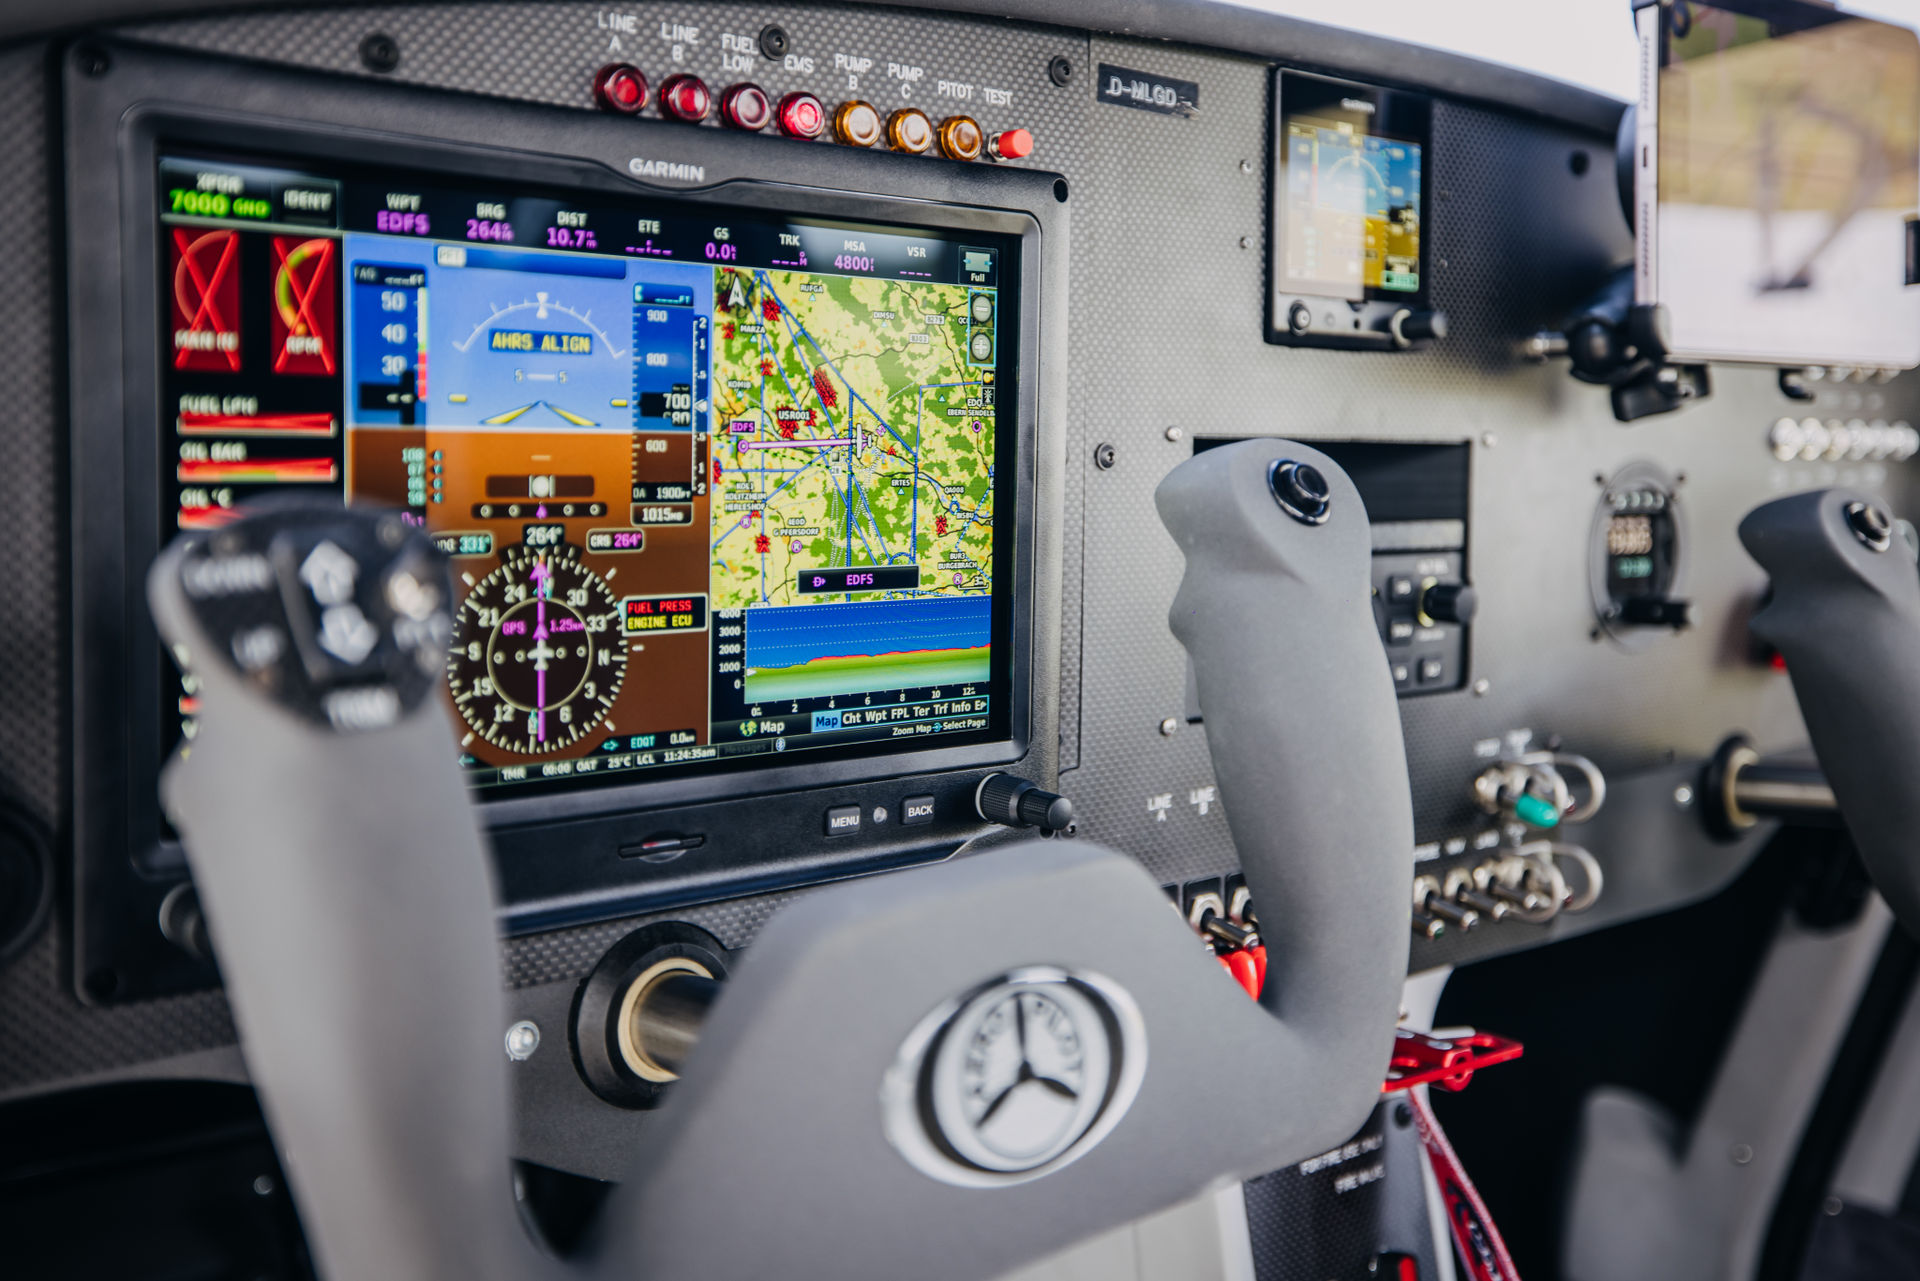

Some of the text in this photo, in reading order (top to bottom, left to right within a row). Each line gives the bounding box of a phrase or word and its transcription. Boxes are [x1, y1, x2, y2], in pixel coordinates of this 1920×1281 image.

[598, 10, 637, 34] LINE
[661, 22, 700, 45] LINE
[609, 35, 621, 50] A
[721, 33, 759, 55] FUEL
[672, 45, 683, 62] B
[723, 53, 755, 74] LOW
[784, 53, 814, 74] EMS
[834, 53, 872, 74] PUMP
[887, 62, 923, 82] PUMP
[848, 75, 858, 91] B
[901, 83, 911, 99] C
[937, 80, 974, 100] PITOT
[983, 87, 1013, 107] TEST
[629, 158, 705, 182] GARMIN
[169, 188, 271, 218] 7000 GND
[284, 189, 332, 211] IDENT
[386, 193, 421, 211] WPT
[476, 202, 506, 220] BRG
[557, 211, 587, 227] DIST
[377, 210, 430, 235] EDFS
[638, 219, 660, 234] ETE
[713, 227, 730, 241] GS
[779, 233, 800, 247] TRK
[843, 240, 866, 253] MSA
[907, 246, 927, 258] VSR
[970, 273, 985, 283] Full
[381, 290, 406, 312] 50
[647, 310, 668, 322] 900
[699, 318, 707, 329] 2
[381, 323, 406, 345] 40
[492, 333, 591, 353] AHRS ALIGN
[700, 339, 705, 350] 1
[381, 355, 406, 377] 30
[646, 353, 668, 367] 800
[514, 370, 523, 382] 5
[559, 371, 568, 383] 5
[663, 393, 690, 410] 700
[778, 410, 811, 420] USR001
[732, 422, 755, 432] EDFS
[646, 440, 667, 453] 600
[698, 483, 706, 495] 2
[891, 479, 910, 487] ERTES
[846, 573, 874, 586] EDFS
[504, 584, 527, 601] 24
[566, 589, 588, 606] 30
[627, 600, 692, 614] FUEL PRESS
[478, 608, 498, 627] 21
[586, 616, 606, 632] 33
[627, 614, 692, 630] ENGINE ECU
[502, 620, 526, 635] GPS
[719, 626, 741, 637] 3000
[468, 642, 481, 661] S
[598, 650, 610, 666] N
[719, 645, 741, 655] 2000
[719, 662, 741, 673] 1000
[584, 682, 595, 698] 3
[734, 680, 741, 689] 0
[792, 704, 798, 713] 2
[828, 700, 835, 709] 4
[865, 697, 870, 706] 6
[900, 693, 905, 702] 8
[931, 690, 941, 699] 10
[494, 705, 513, 722] 12
[560, 705, 571, 723] 6
[815, 716, 838, 728] Map
[843, 712, 861, 725] Cht
[865, 709, 887, 723] Wpt
[891, 707, 910, 719] FPL
[913, 705, 930, 717] Ter
[933, 703, 948, 715] Trf
[951, 701, 971, 713] Info
[760, 721, 785, 734] Map
[892, 718, 986, 736] Zoom Map Select Page
[501, 768, 526, 780] TMR
[543, 761, 571, 776] 00:00
[576, 760, 597, 773] OAT
[636, 753, 655, 765] LCL
[908, 804, 934, 818] BACK
[831, 814, 860, 829] MENU
